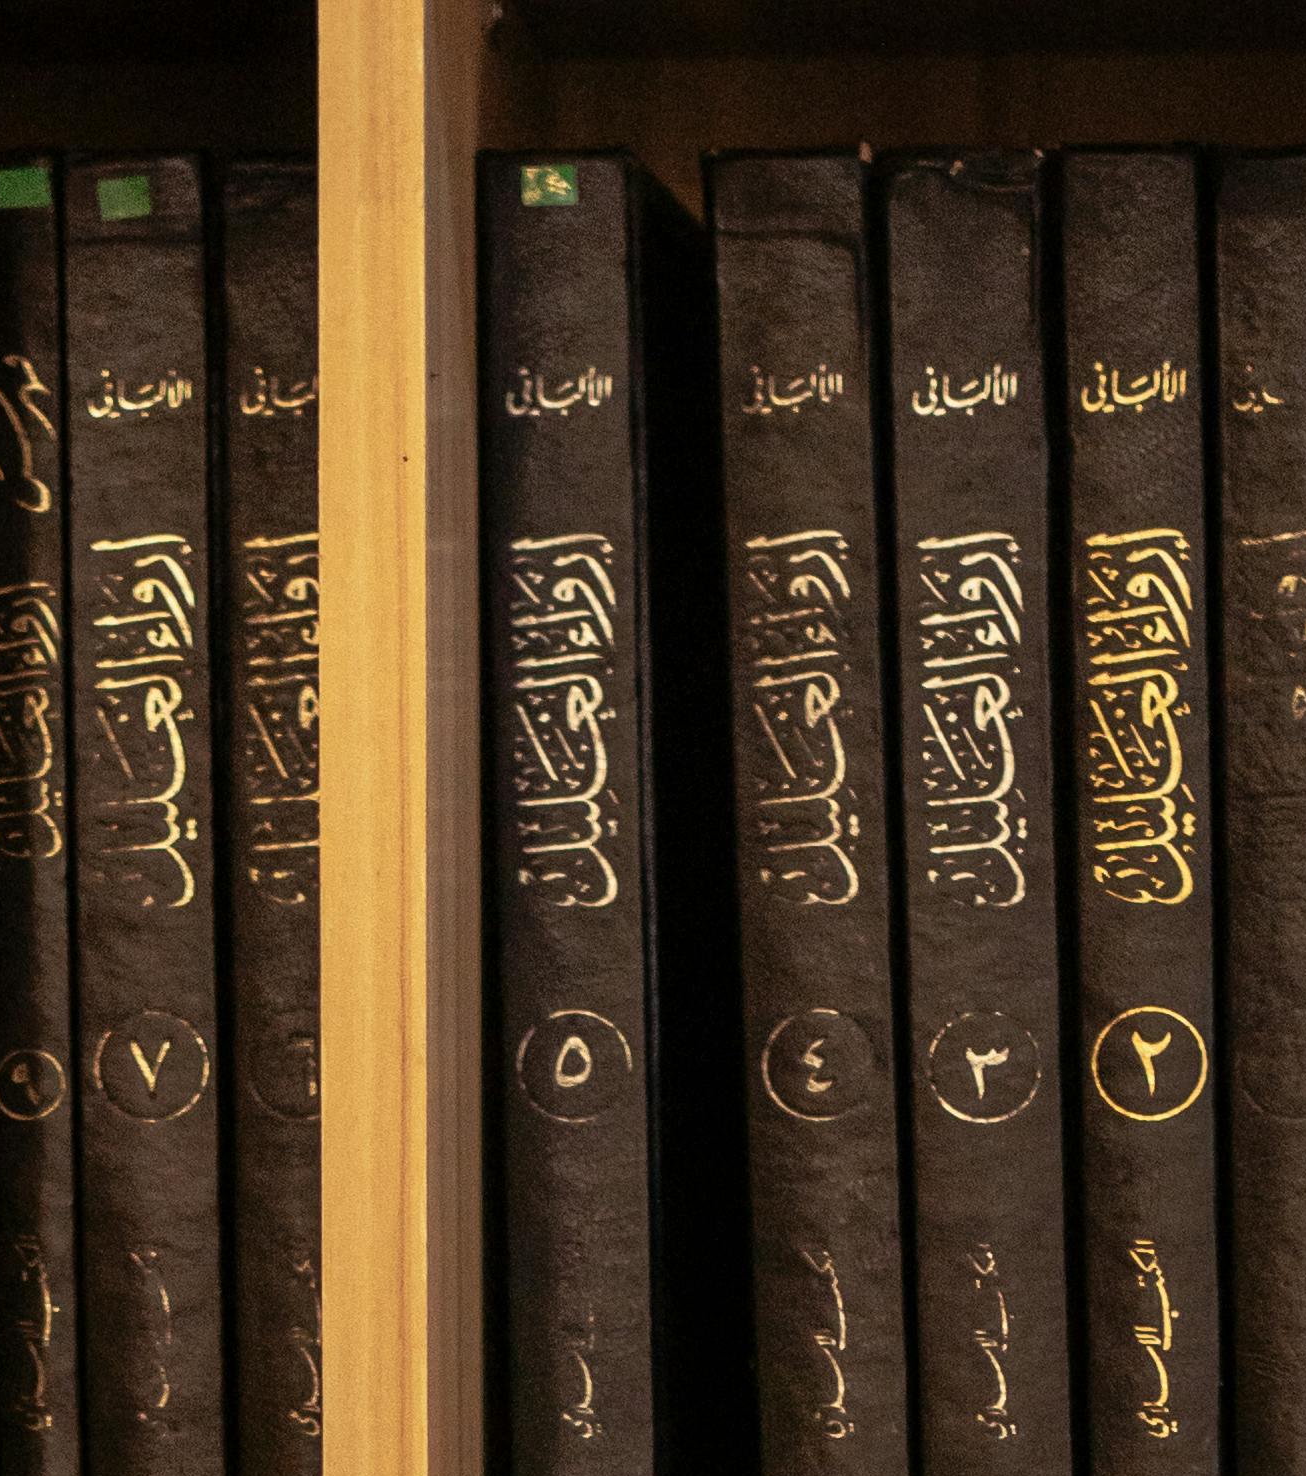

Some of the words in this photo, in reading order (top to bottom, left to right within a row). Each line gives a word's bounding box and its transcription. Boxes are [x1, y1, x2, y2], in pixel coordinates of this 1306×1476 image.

[555, 1035, 592, 1088] ٥
[802, 1039, 833, 1093] ٤
[965, 1047, 1009, 1099] ٣
[1131, 1031, 1172, 1095] ٢
